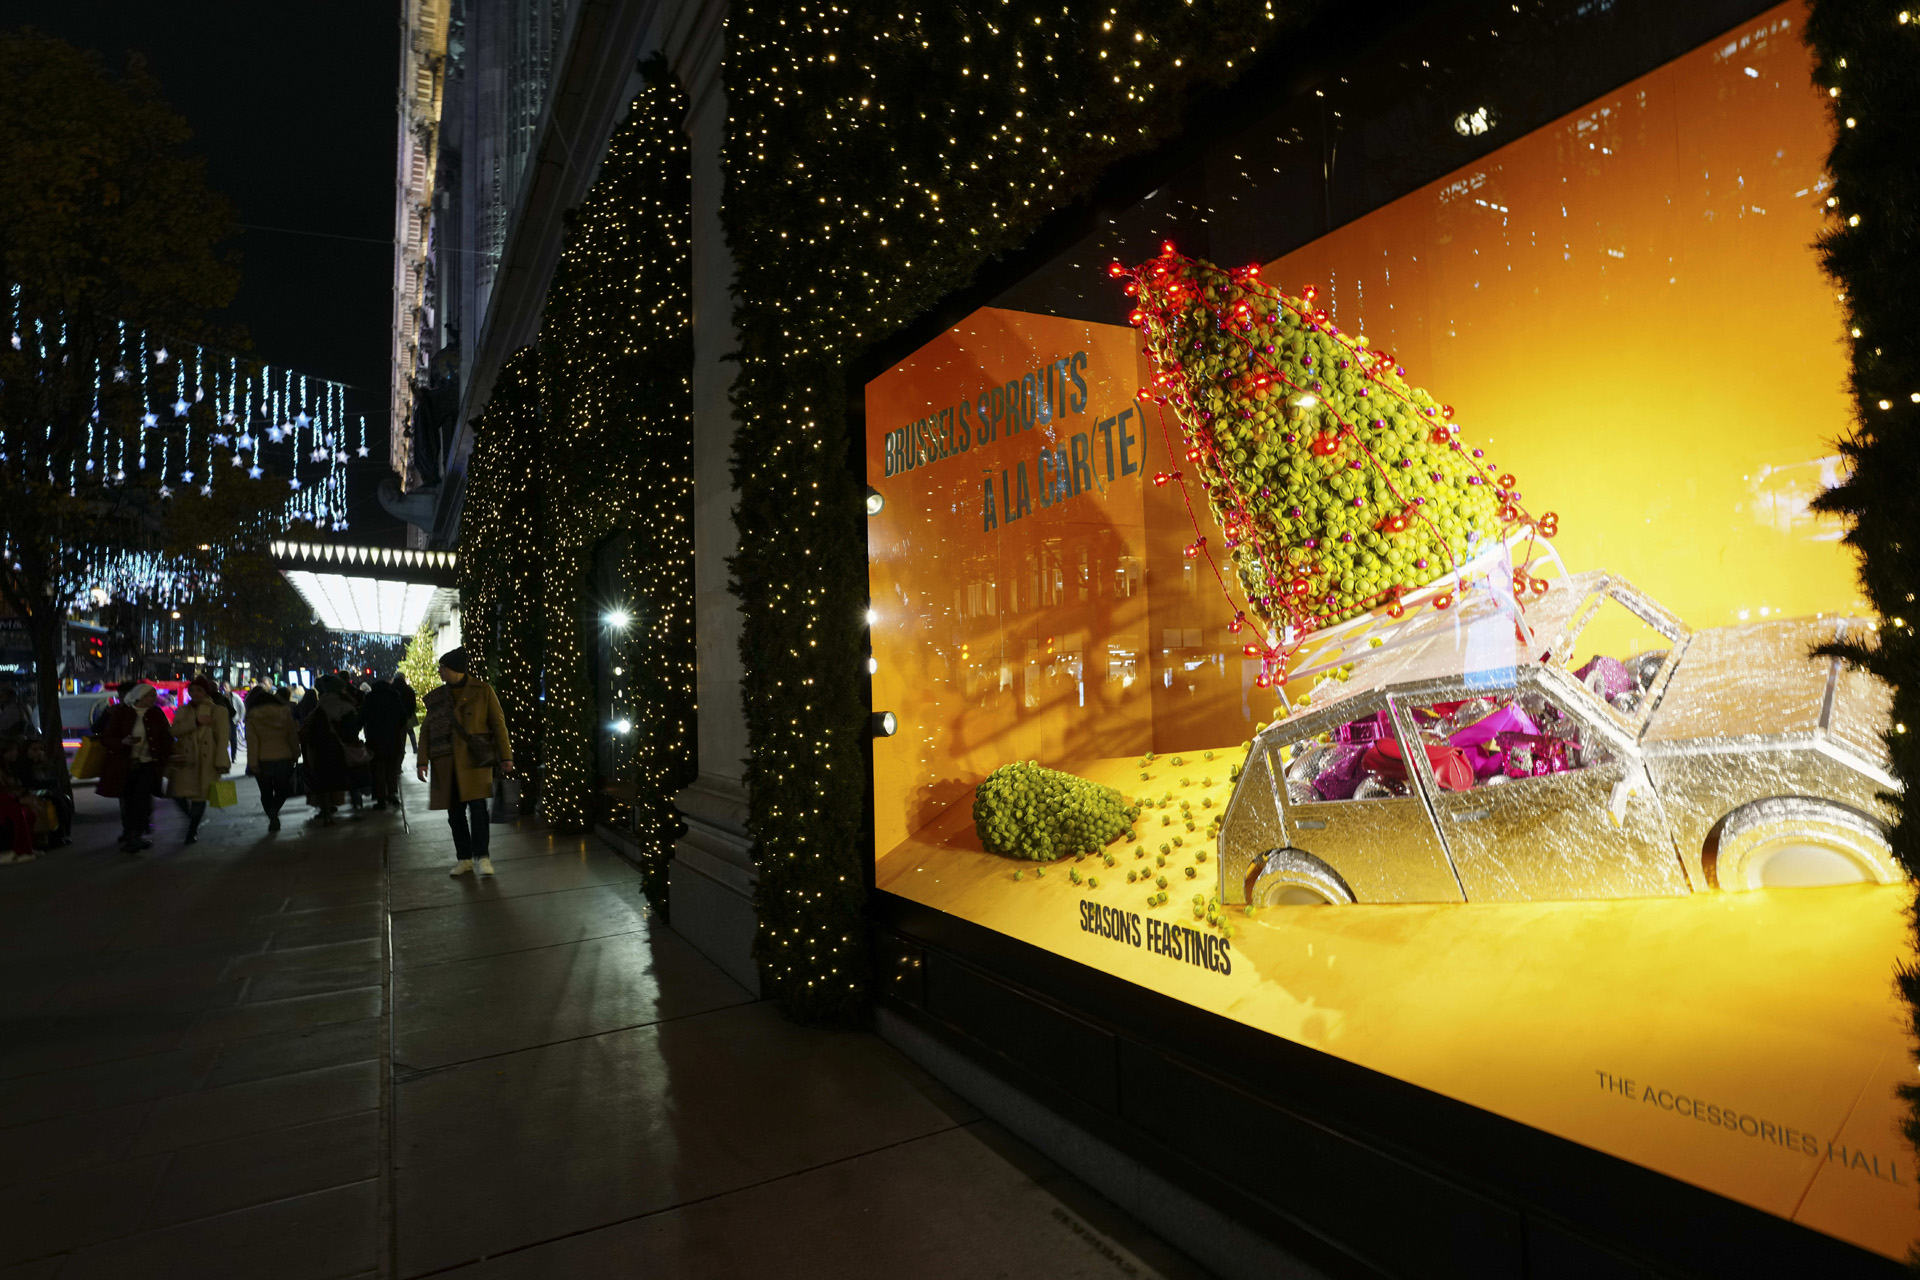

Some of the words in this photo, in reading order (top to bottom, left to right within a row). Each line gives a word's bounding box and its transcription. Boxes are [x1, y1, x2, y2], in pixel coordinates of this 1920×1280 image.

[885, 400, 971, 478] BRUSSELS
[977, 350, 1088, 446] SPROUTS
[1002, 460, 1033, 524] LA
[1037, 399, 1147, 510] CAR(TE)
[1080, 899, 1142, 948] SEASON'S
[1146, 917, 1232, 976] FEASTINGS
[1595, 1069, 1637, 1101] THE
[1643, 1085, 1818, 1157] ACCESSORIES
[1827, 1139, 1909, 1188] HALL
